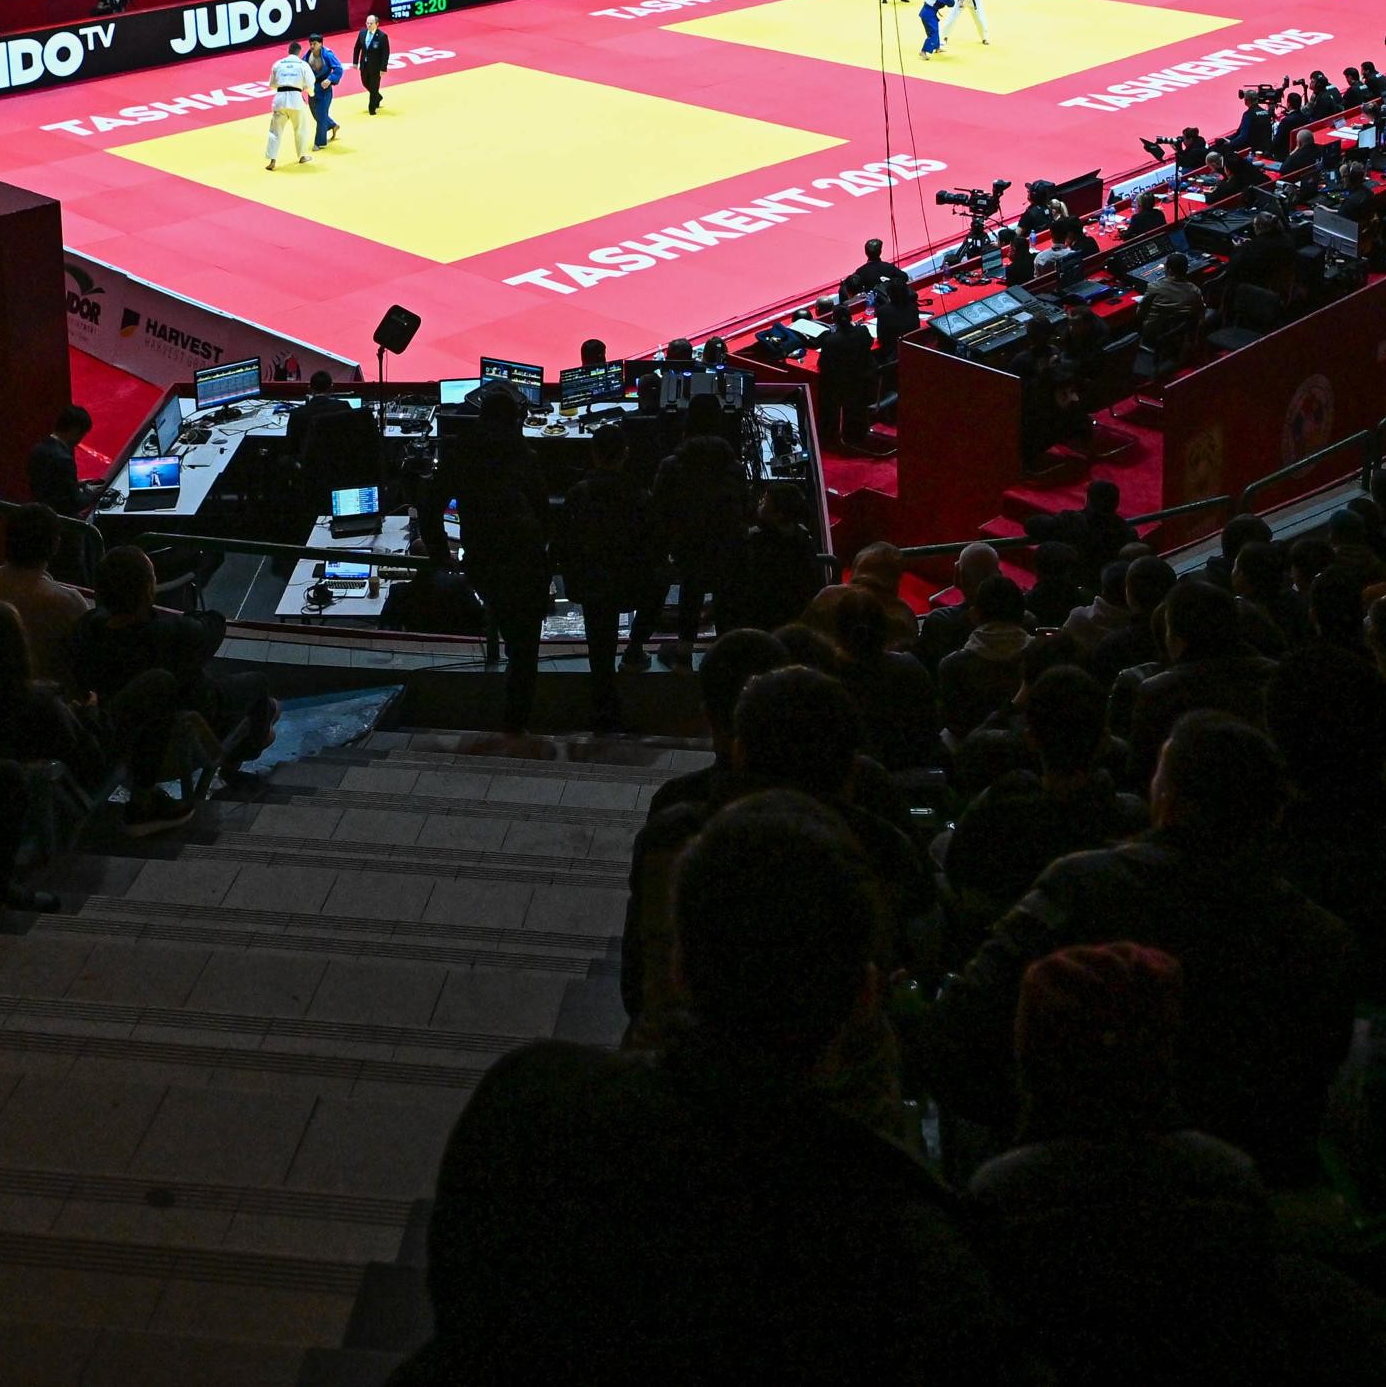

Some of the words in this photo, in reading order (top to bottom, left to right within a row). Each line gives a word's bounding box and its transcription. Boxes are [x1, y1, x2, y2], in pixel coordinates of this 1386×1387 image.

[80, 23, 117, 51] TV
[1058, 49, 1255, 112] TASHKENT
[1239, 28, 1334, 57] 2025
[502, 187, 834, 294] TASHKENT
[812, 154, 948, 198] 2025
[146, 318, 224, 364] HARVEST
